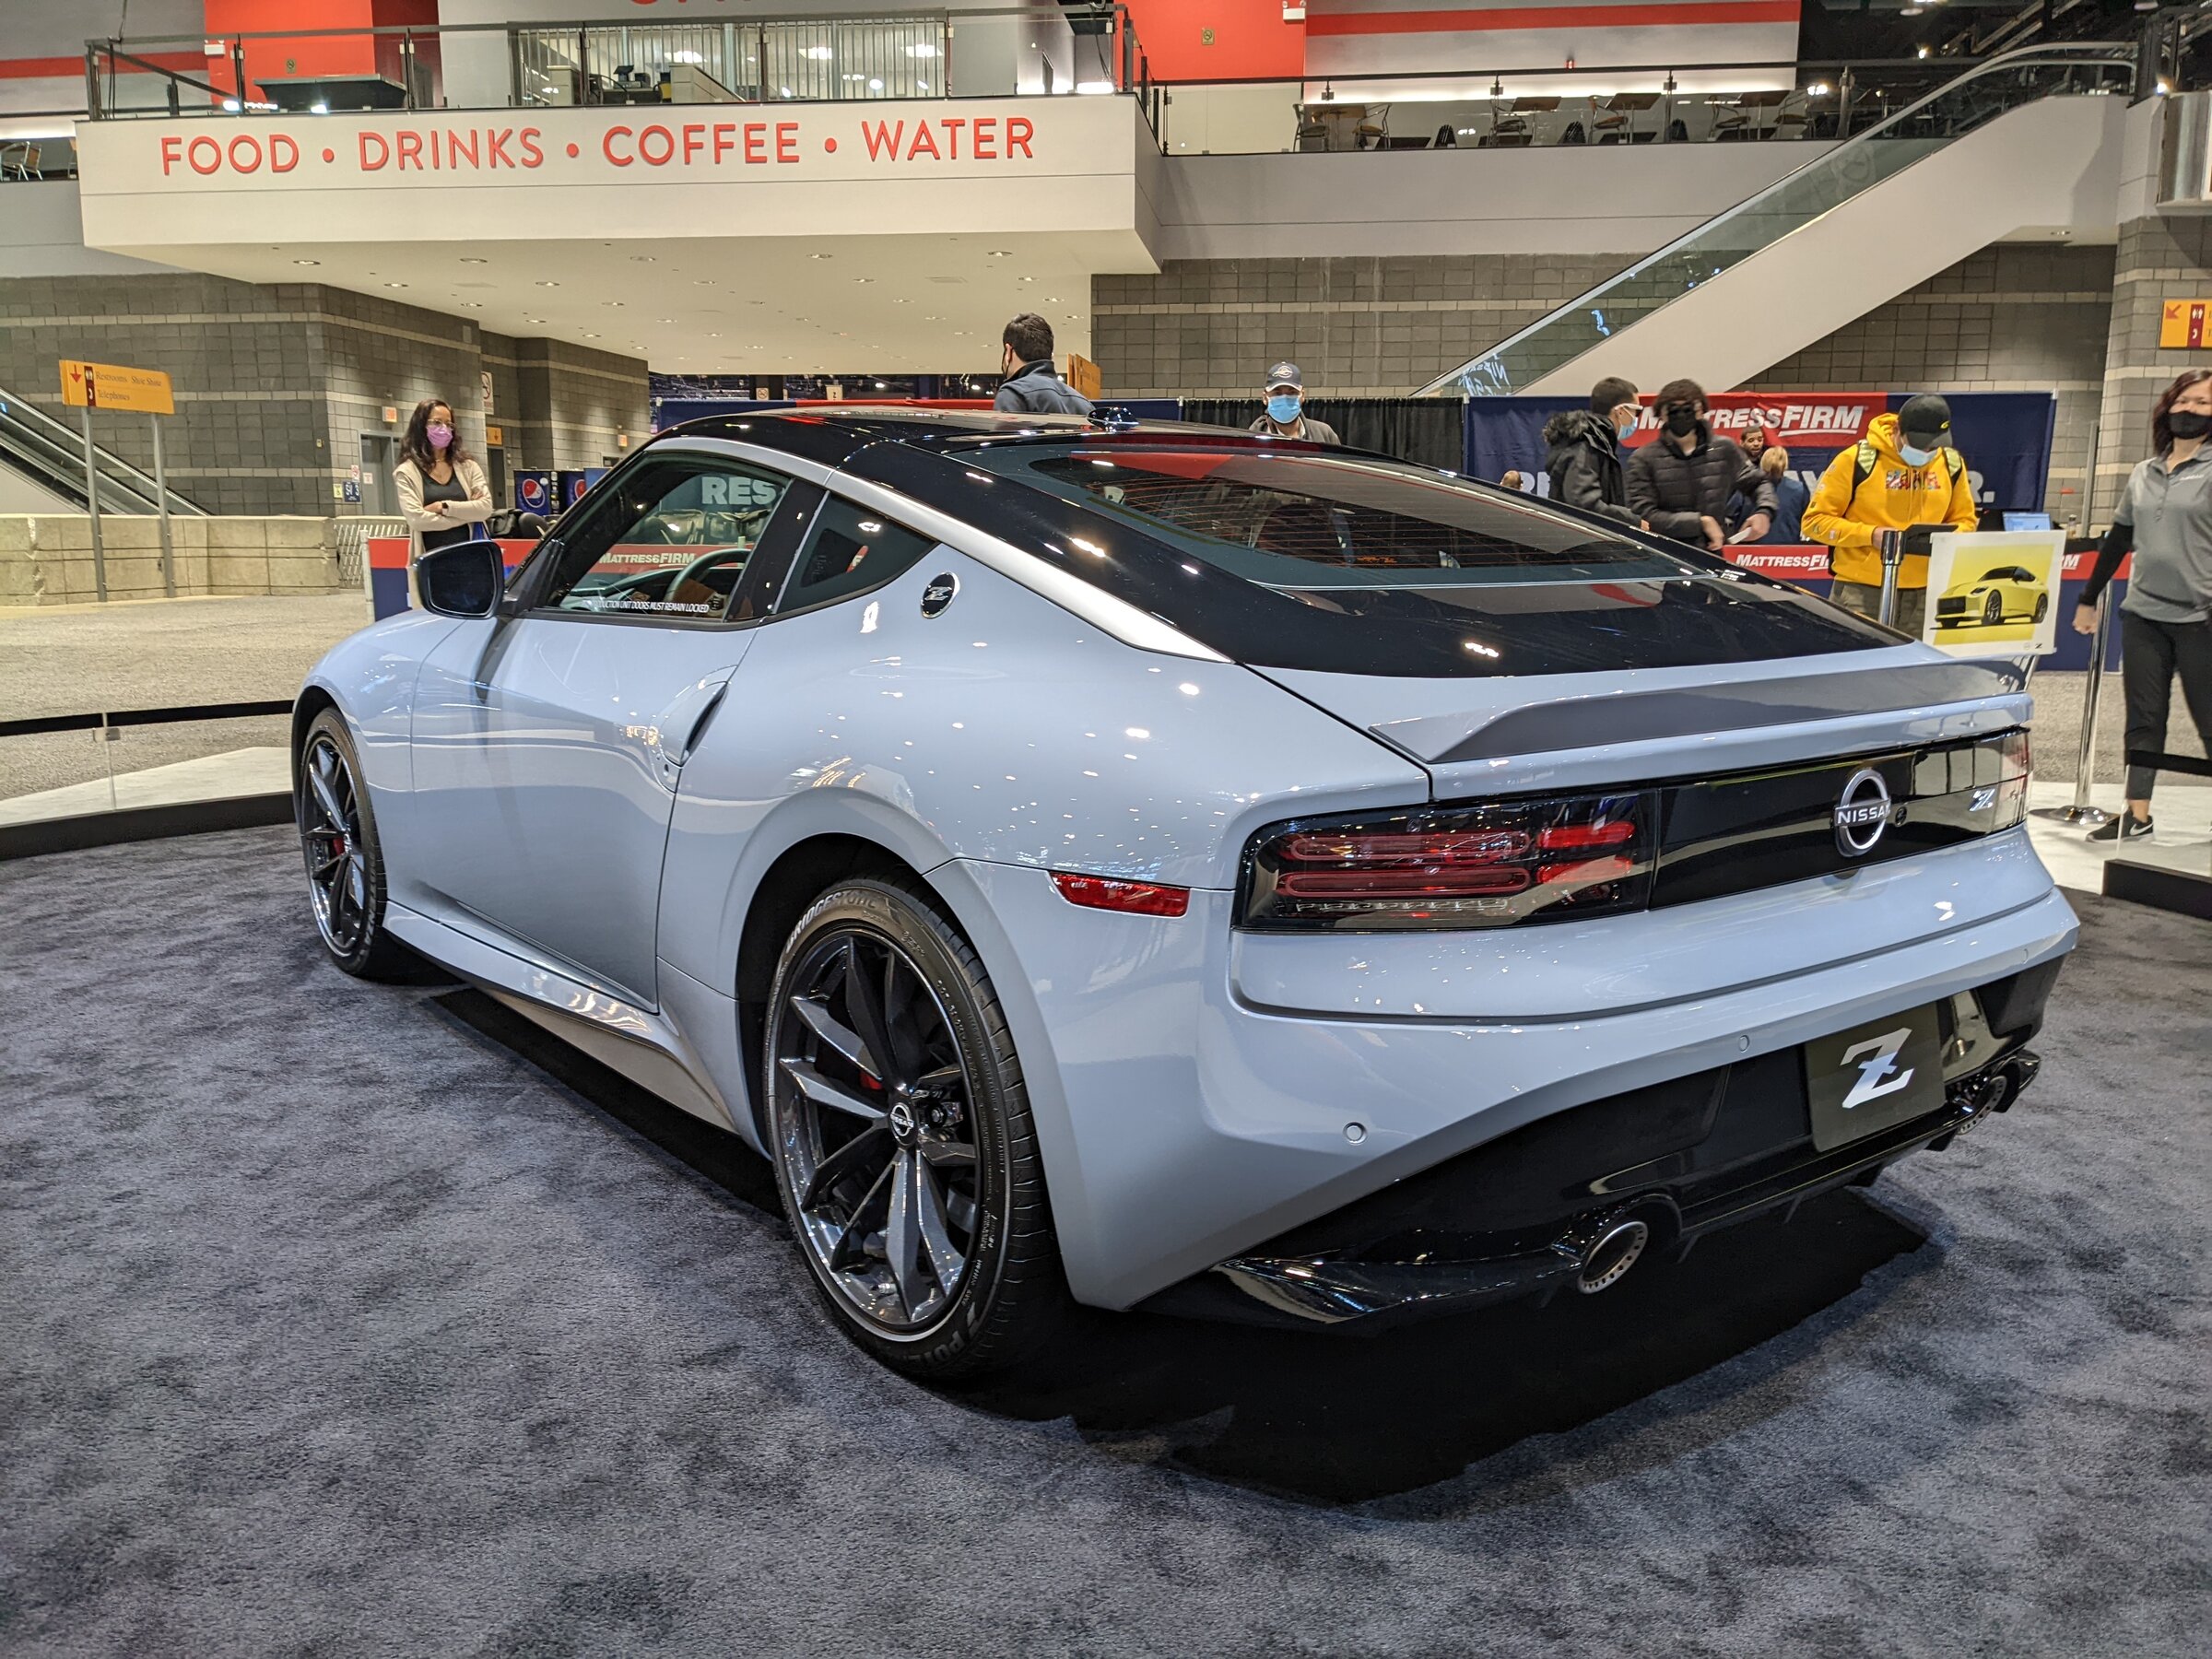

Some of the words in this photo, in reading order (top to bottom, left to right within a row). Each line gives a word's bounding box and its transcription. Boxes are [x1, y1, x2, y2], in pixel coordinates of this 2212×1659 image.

[160, 134, 300, 176] FOOD
[358, 127, 545, 171] DRINKS
[602, 123, 800, 167] COFFEE
[861, 117, 1033, 161] WATER
[701, 476, 777, 505] RES
[632, 601, 650, 610] DOORS
[650, 602, 665, 610] MUST
[686, 604, 710, 613] LOCKED
[1840, 1027, 1915, 1109] Z
